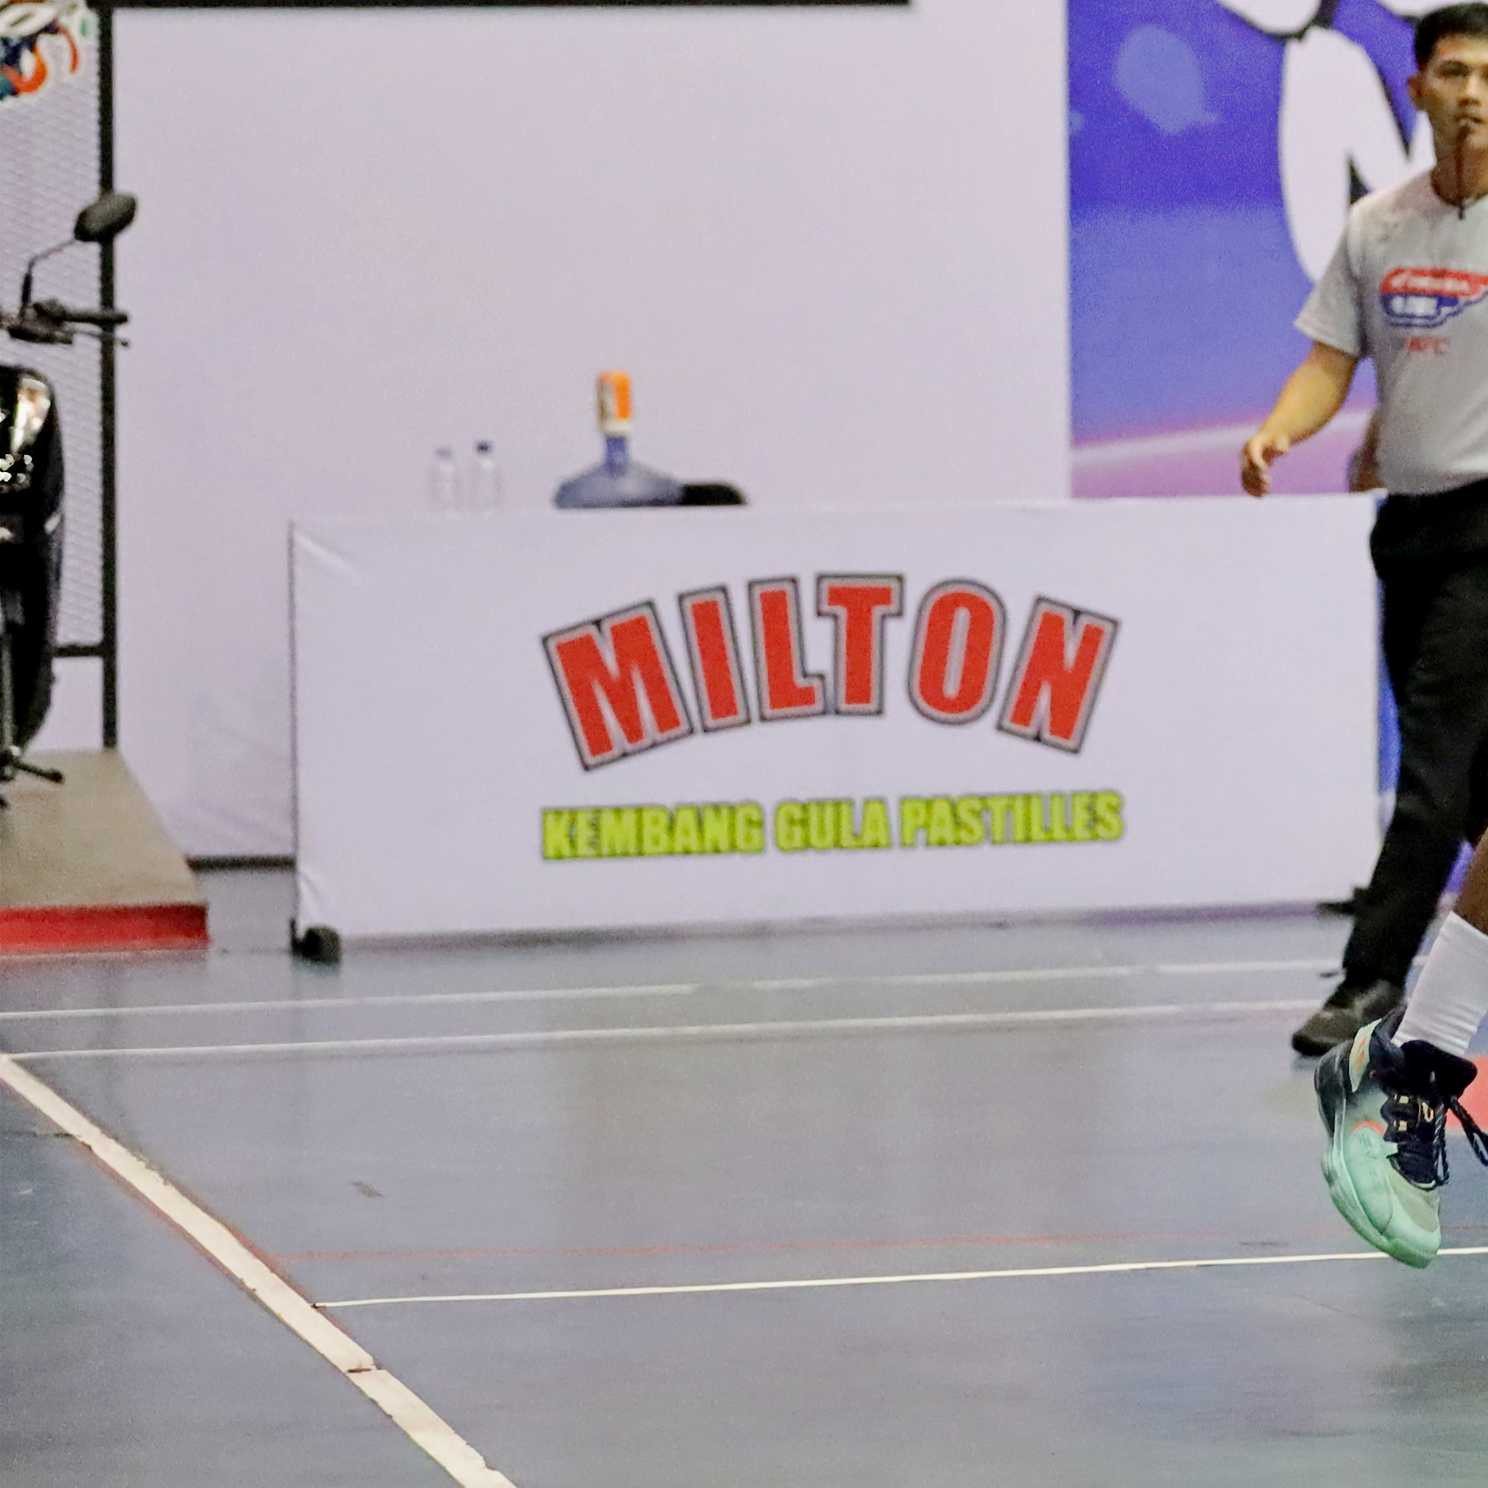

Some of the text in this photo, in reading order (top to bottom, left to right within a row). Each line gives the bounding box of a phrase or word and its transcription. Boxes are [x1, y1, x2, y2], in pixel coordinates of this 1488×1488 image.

[542, 572, 1123, 771] MILTON
[541, 790, 1126, 860] KEMBANG GULA PASTILLES
